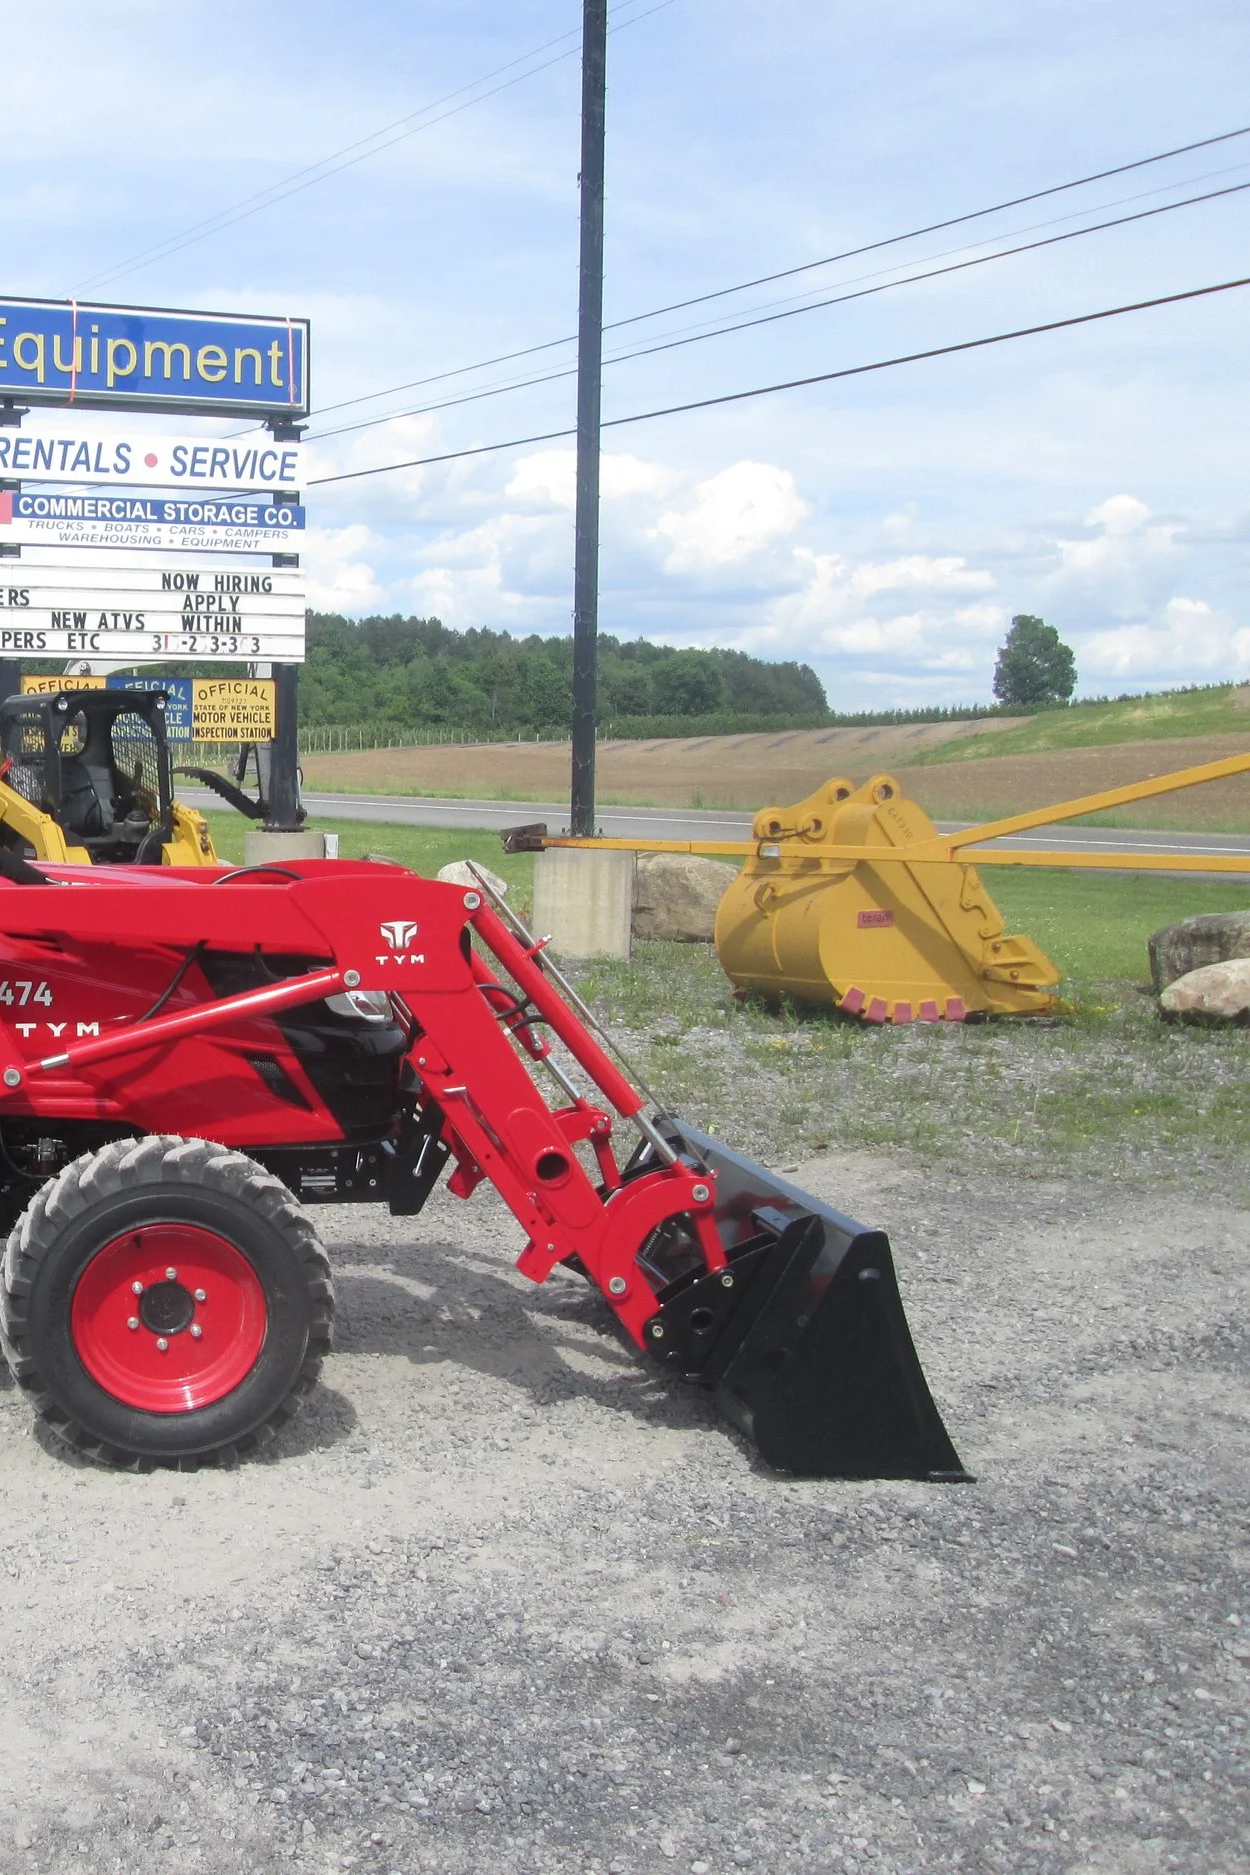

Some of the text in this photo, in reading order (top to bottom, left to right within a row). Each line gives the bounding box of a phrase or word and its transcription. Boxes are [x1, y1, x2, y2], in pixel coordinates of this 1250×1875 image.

[170, 445, 298, 482] SERVICE
[18, 497, 297, 526] COMMERCIAL STORAGE CO.
[28, 520, 289, 540] TRUCKS BOATS CARS CAMPERS
[58, 532, 260, 549] WAREHOUSING EQUIPMENT
[161, 573, 272, 593] NOW HIRING
[183, 594, 240, 612] APPLY
[51, 611, 145, 631] NEW ATVS
[181, 615, 242, 633] WITHIN
[67, 632, 100, 650] ETC
[27, 680, 98, 694] OFFICIA
[124, 681, 186, 700] FFICIAL
[198, 682, 268, 701] OFFICIAL
[193, 712, 226, 723] MOTOR
[230, 712, 271, 723] VEHICLE
[166, 726, 190, 738] ATION
[192, 727, 272, 738] INSPECTION STATION
[375, 954, 425, 966] TYM
[15, 1021, 100, 1038] TYM
